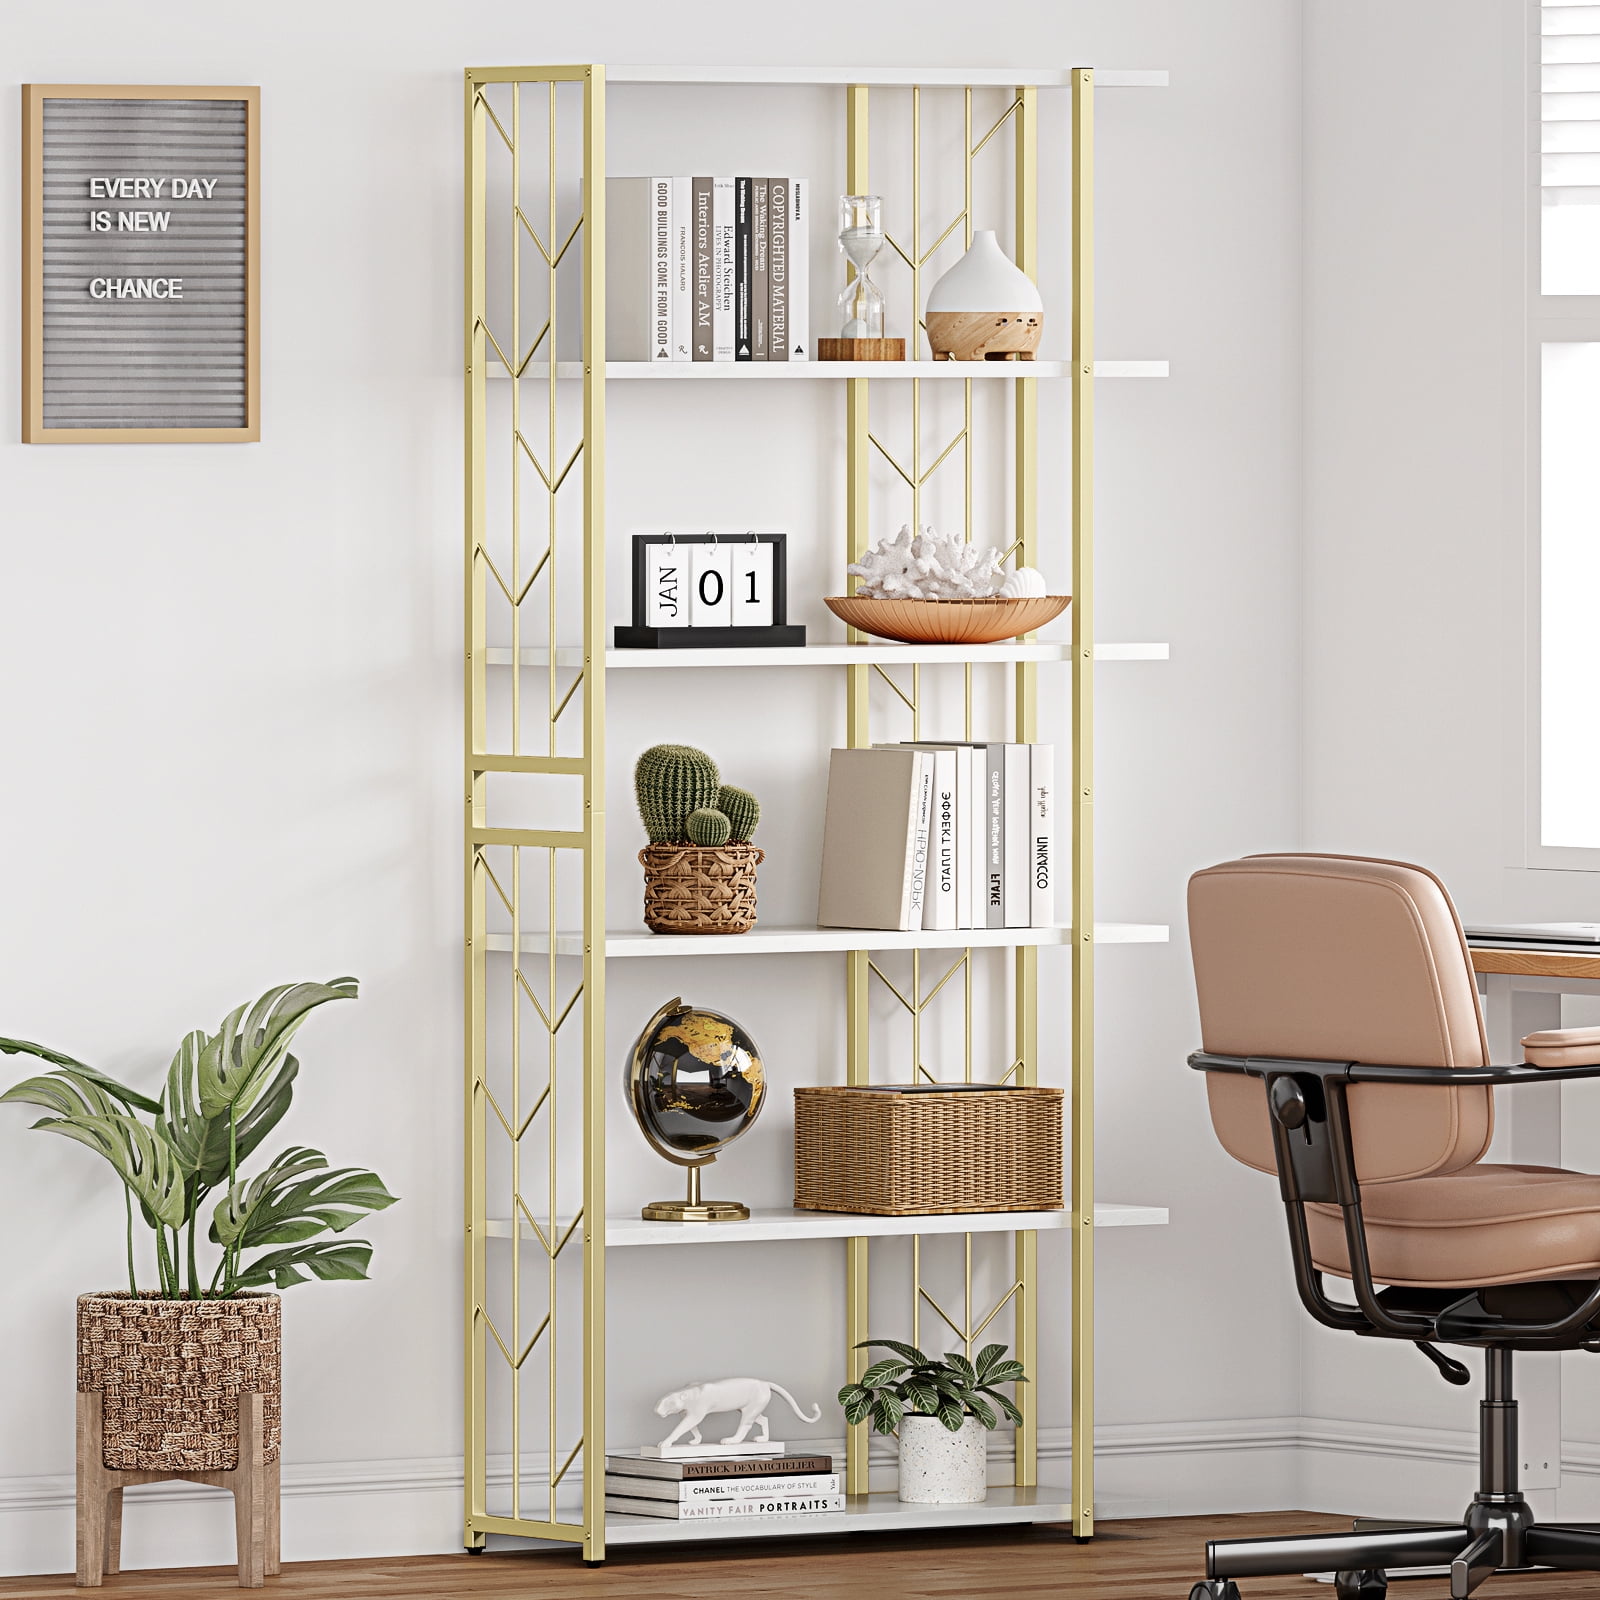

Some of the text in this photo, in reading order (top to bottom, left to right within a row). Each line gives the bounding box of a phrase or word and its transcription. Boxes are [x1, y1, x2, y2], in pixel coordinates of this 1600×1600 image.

[90, 178, 218, 198] EVERY DAY
[90, 211, 170, 232] IS NEW
[758, 185, 767, 272] The Waking Dream
[698, 192, 710, 326] Interiors Atelier AM
[715, 248, 722, 256] IN
[657, 182, 668, 345] GOOD BUILDINGS COME FROM GOOD
[724, 226, 733, 311] Edward Steichen
[772, 185, 785, 352] COPYRIGHTED MATERIAL
[90, 278, 183, 299] CHANCE
[658, 566, 678, 617] JAN
[687, 1465, 730, 1475] PATRICK
[734, 1461, 815, 1472] DEMARCHELIER
[693, 1486, 725, 1495] CHANEL
[742, 1484, 786, 1492] VOCABULARY
[683, 1506, 723, 1517] VANITY
[728, 1504, 754, 1514] FAIR
[760, 1500, 828, 1513] PORTRAITS
